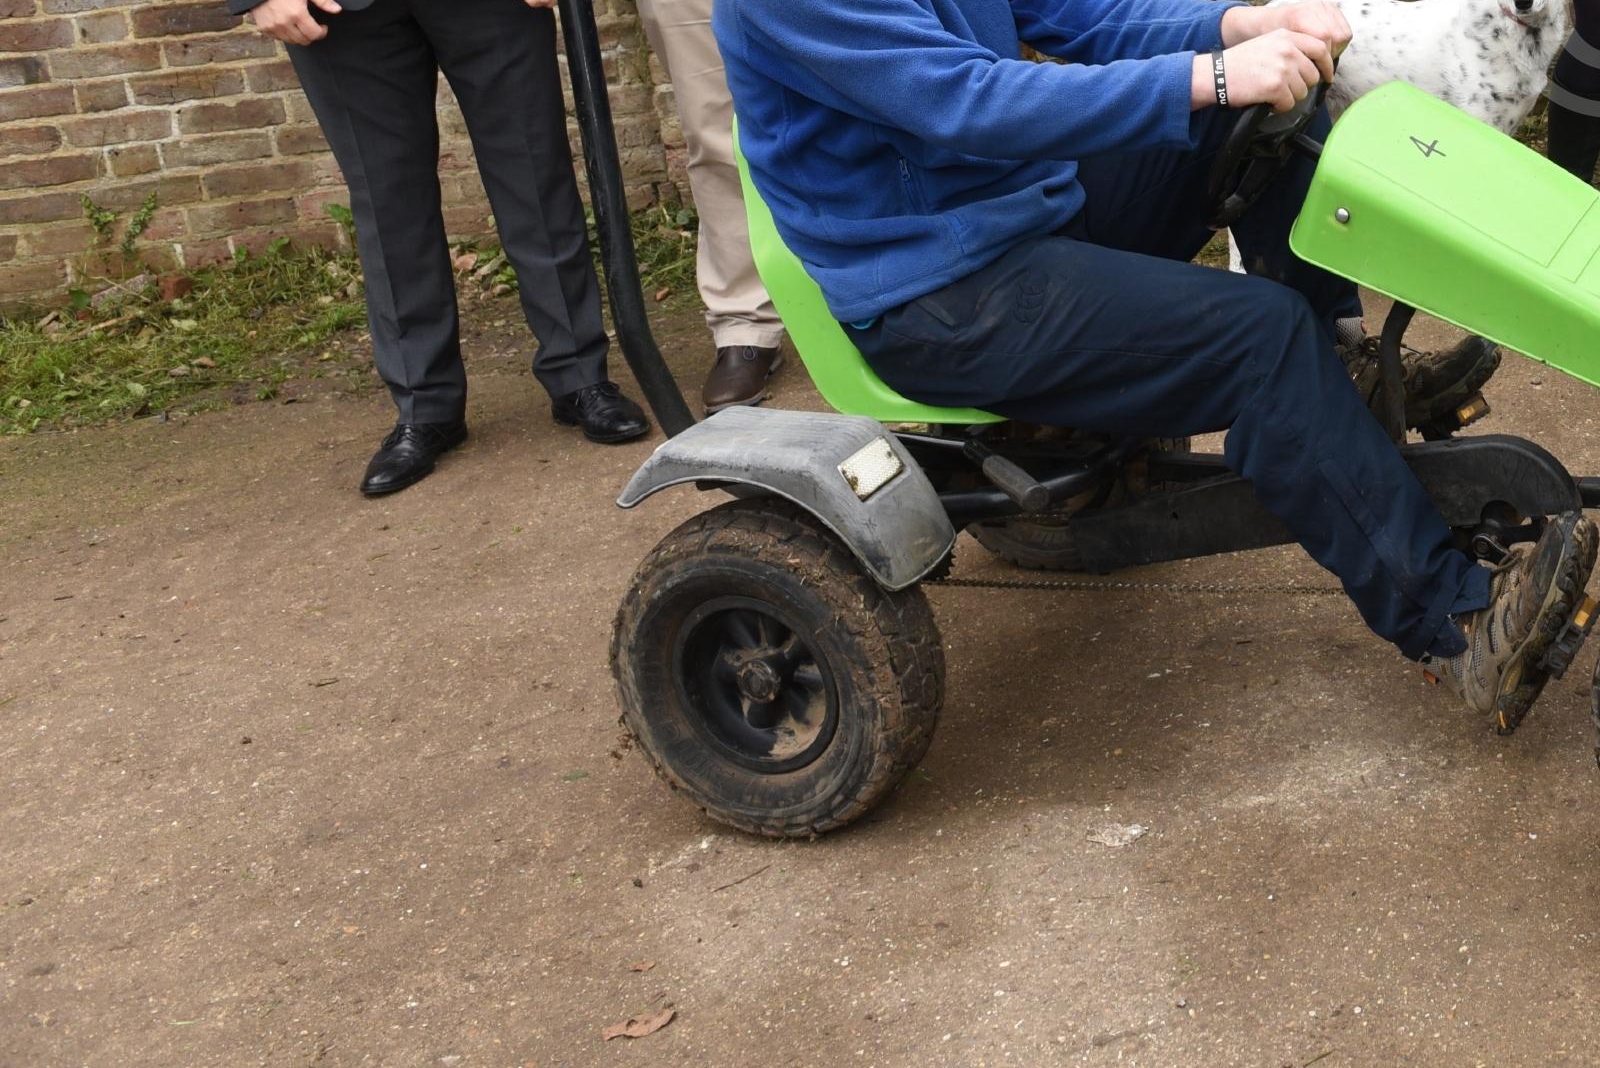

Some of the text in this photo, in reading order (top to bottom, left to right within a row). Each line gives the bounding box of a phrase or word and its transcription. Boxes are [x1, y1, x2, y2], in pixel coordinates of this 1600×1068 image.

[1215, 57, 1224, 75] fan.
[1217, 88, 1227, 105] not
[1410, 135, 1446, 159] 4
